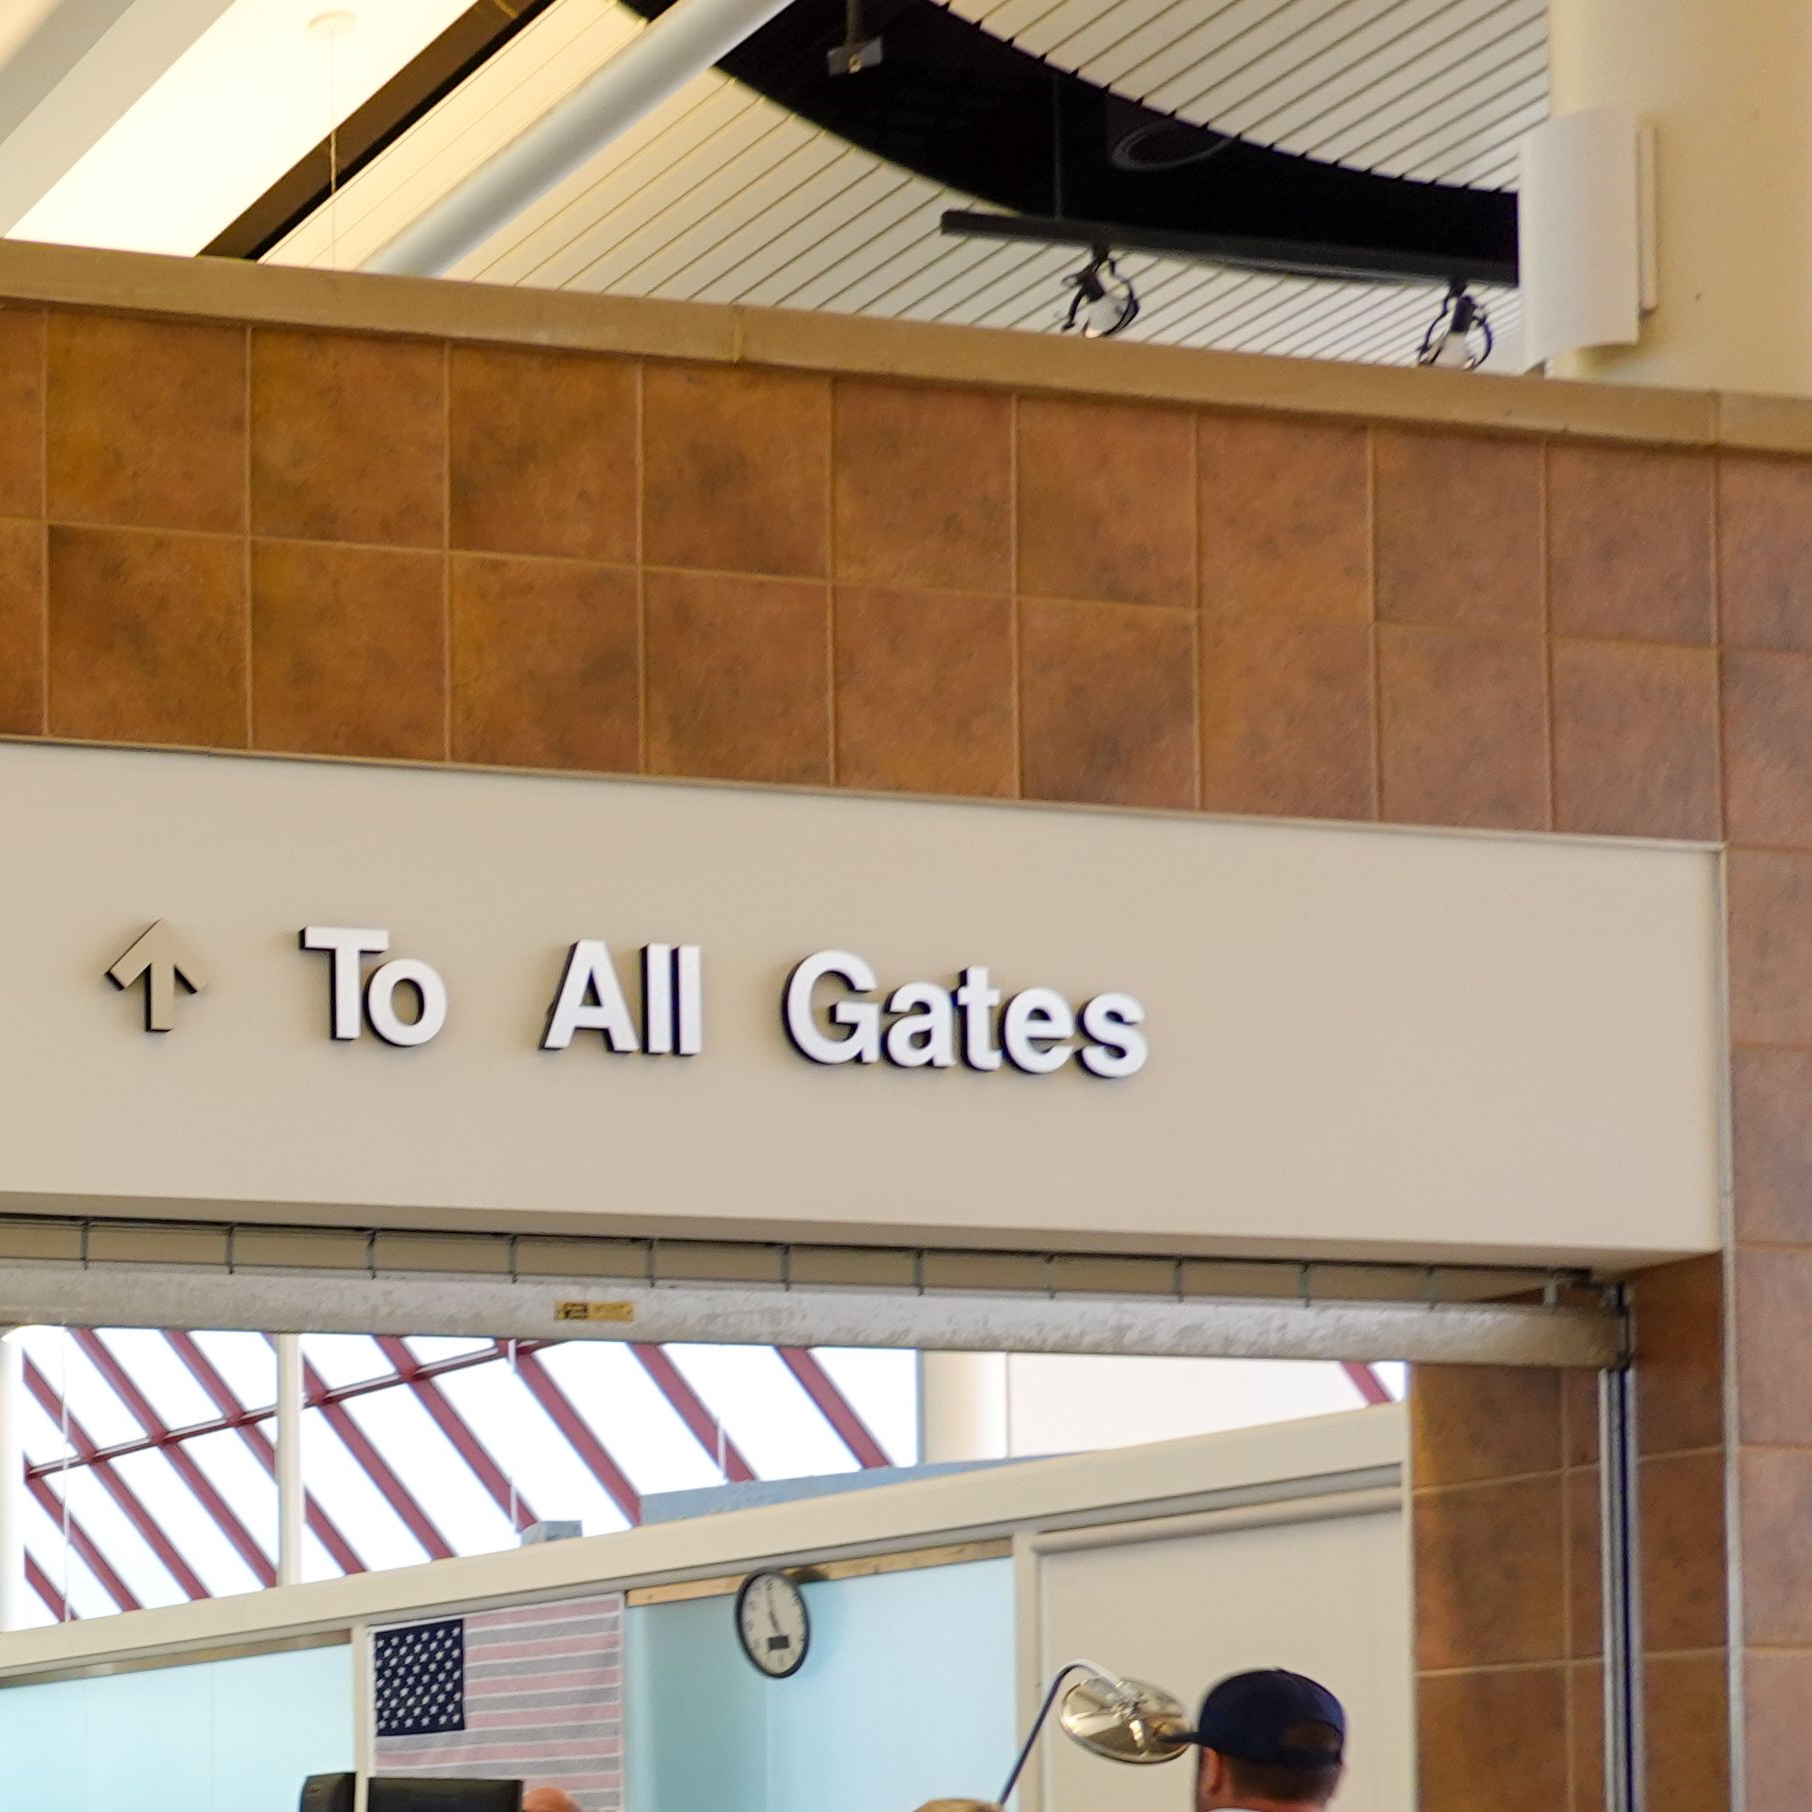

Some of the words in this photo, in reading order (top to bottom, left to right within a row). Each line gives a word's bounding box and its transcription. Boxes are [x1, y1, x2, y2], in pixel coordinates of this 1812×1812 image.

[299, 926, 447, 1047] To
[539, 939, 702, 1055] All
[782, 949, 1148, 1078] Gates
